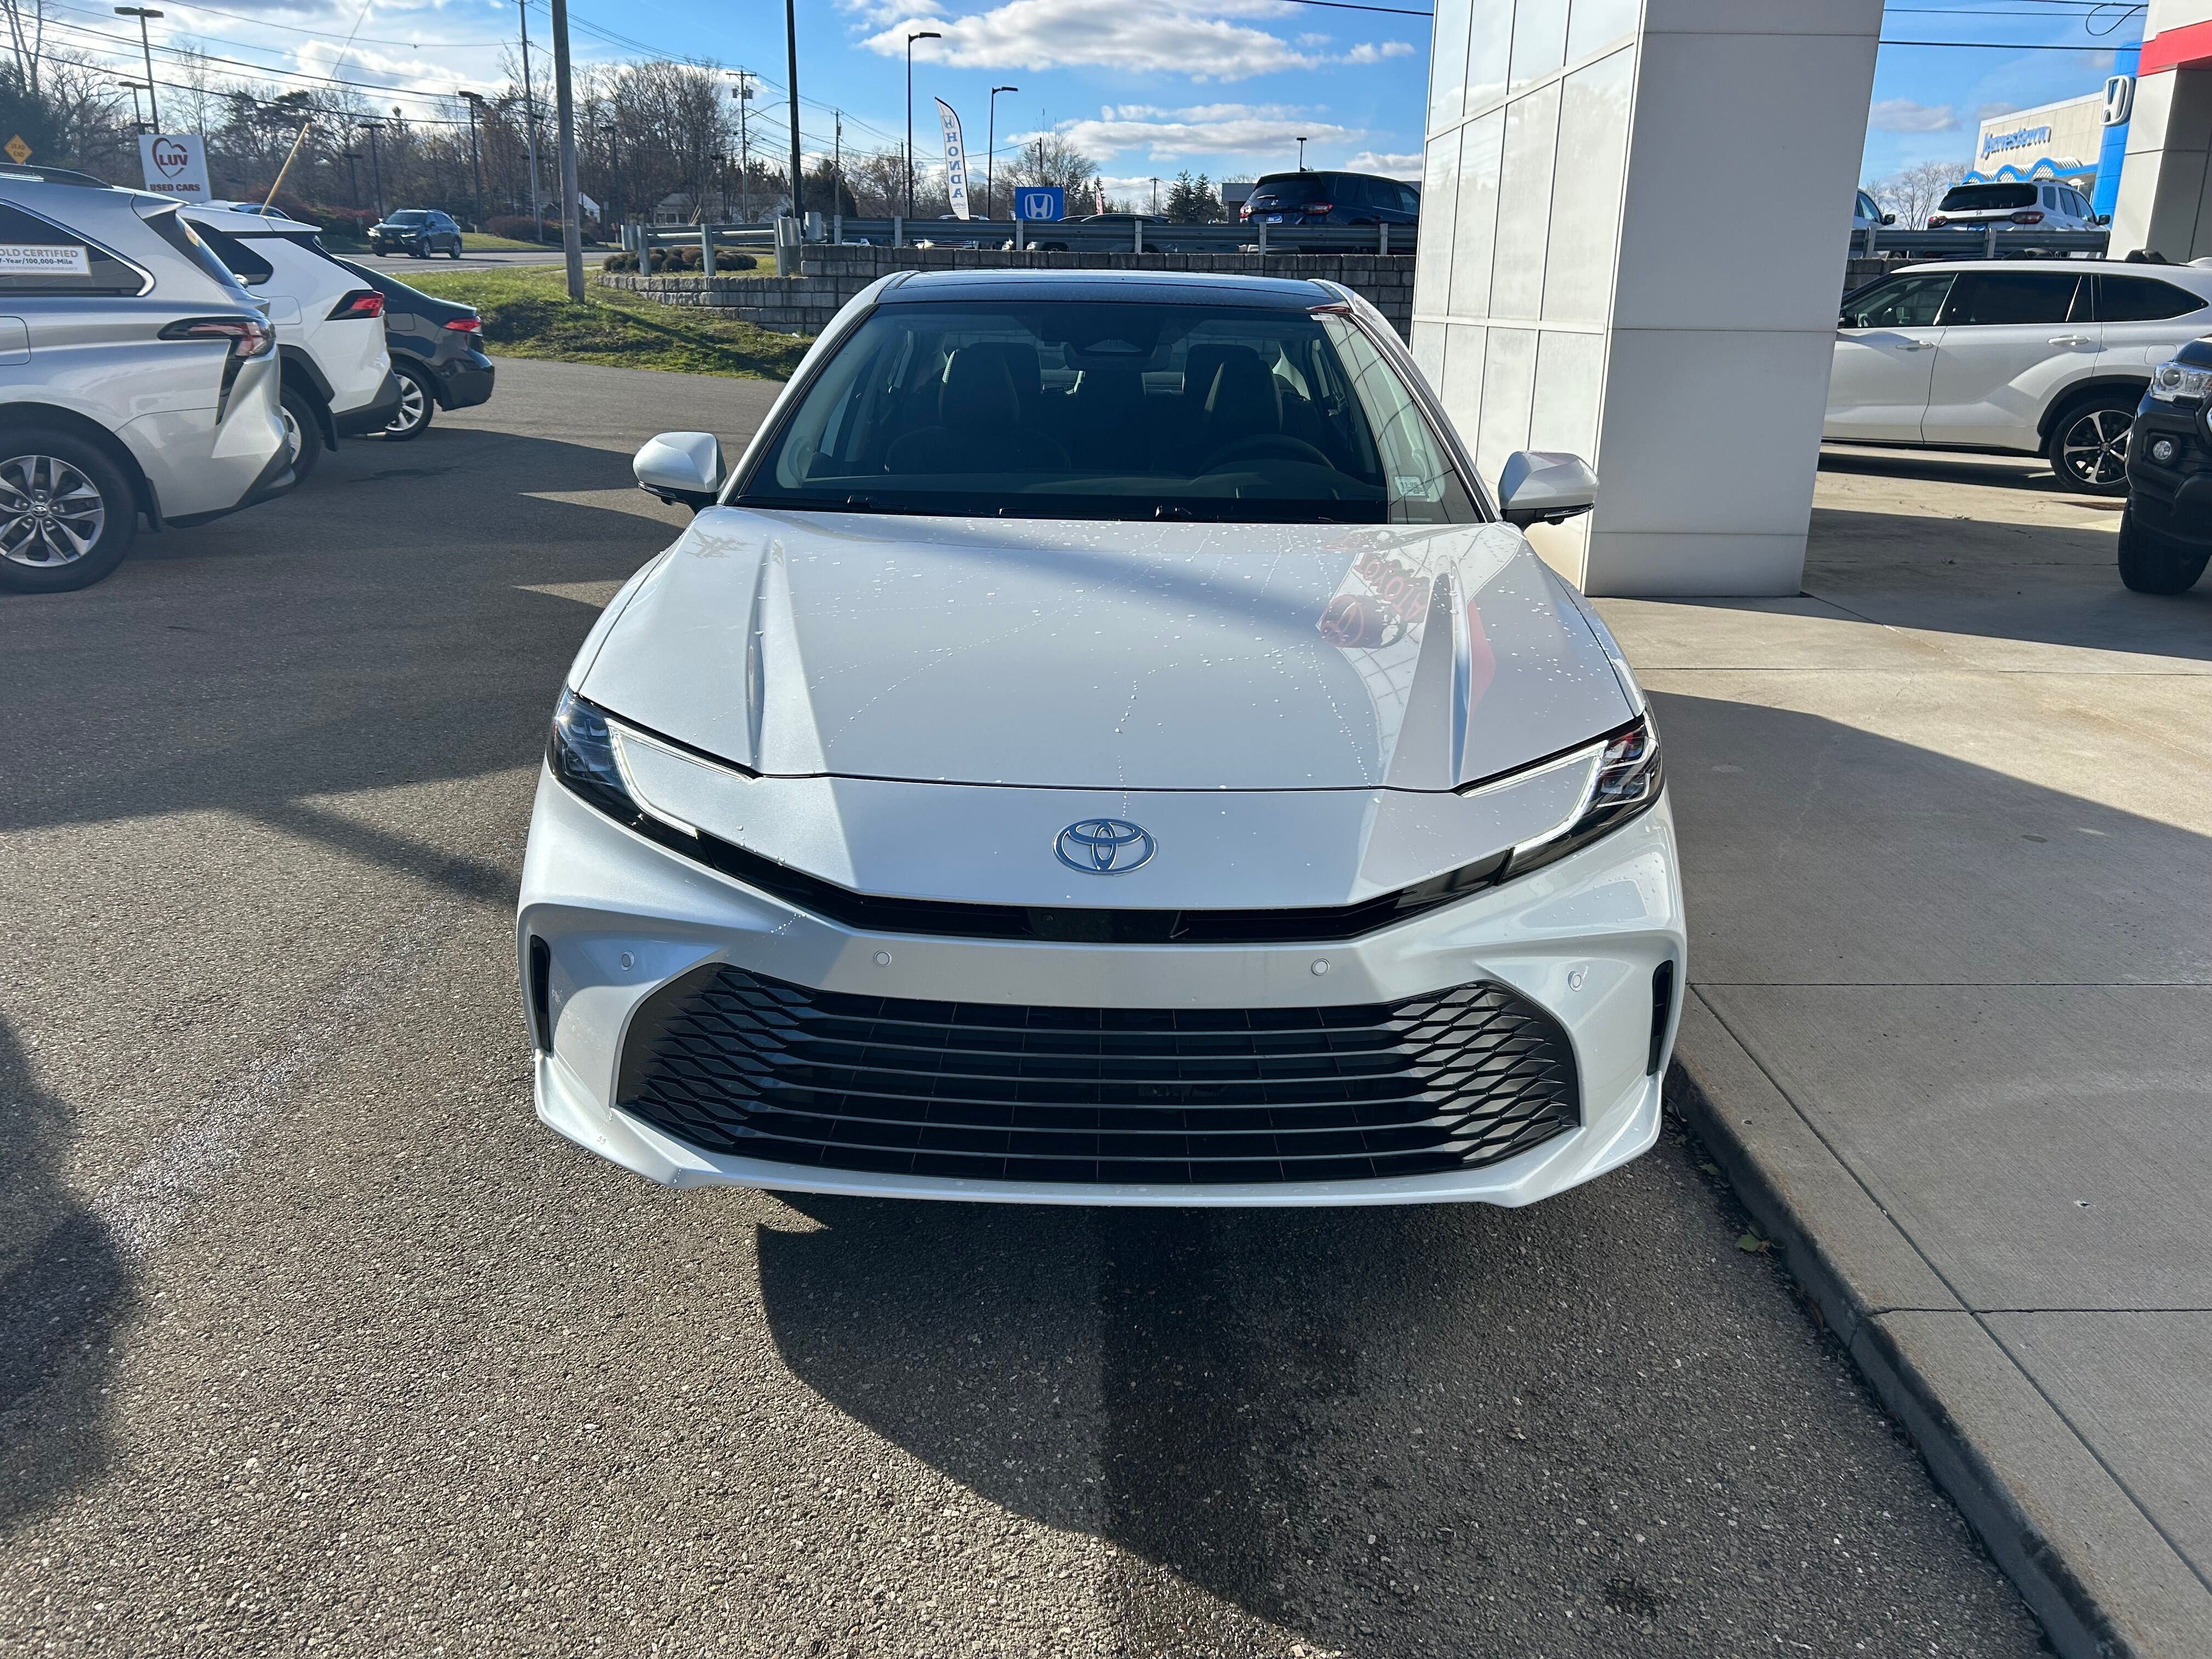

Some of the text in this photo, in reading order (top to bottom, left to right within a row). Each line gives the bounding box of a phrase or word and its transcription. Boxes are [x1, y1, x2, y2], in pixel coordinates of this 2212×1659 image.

[1980, 126, 2051, 159] Jamestown
[158, 154, 188, 166] LUV
[22, 249, 78, 257] CERTIFIED
